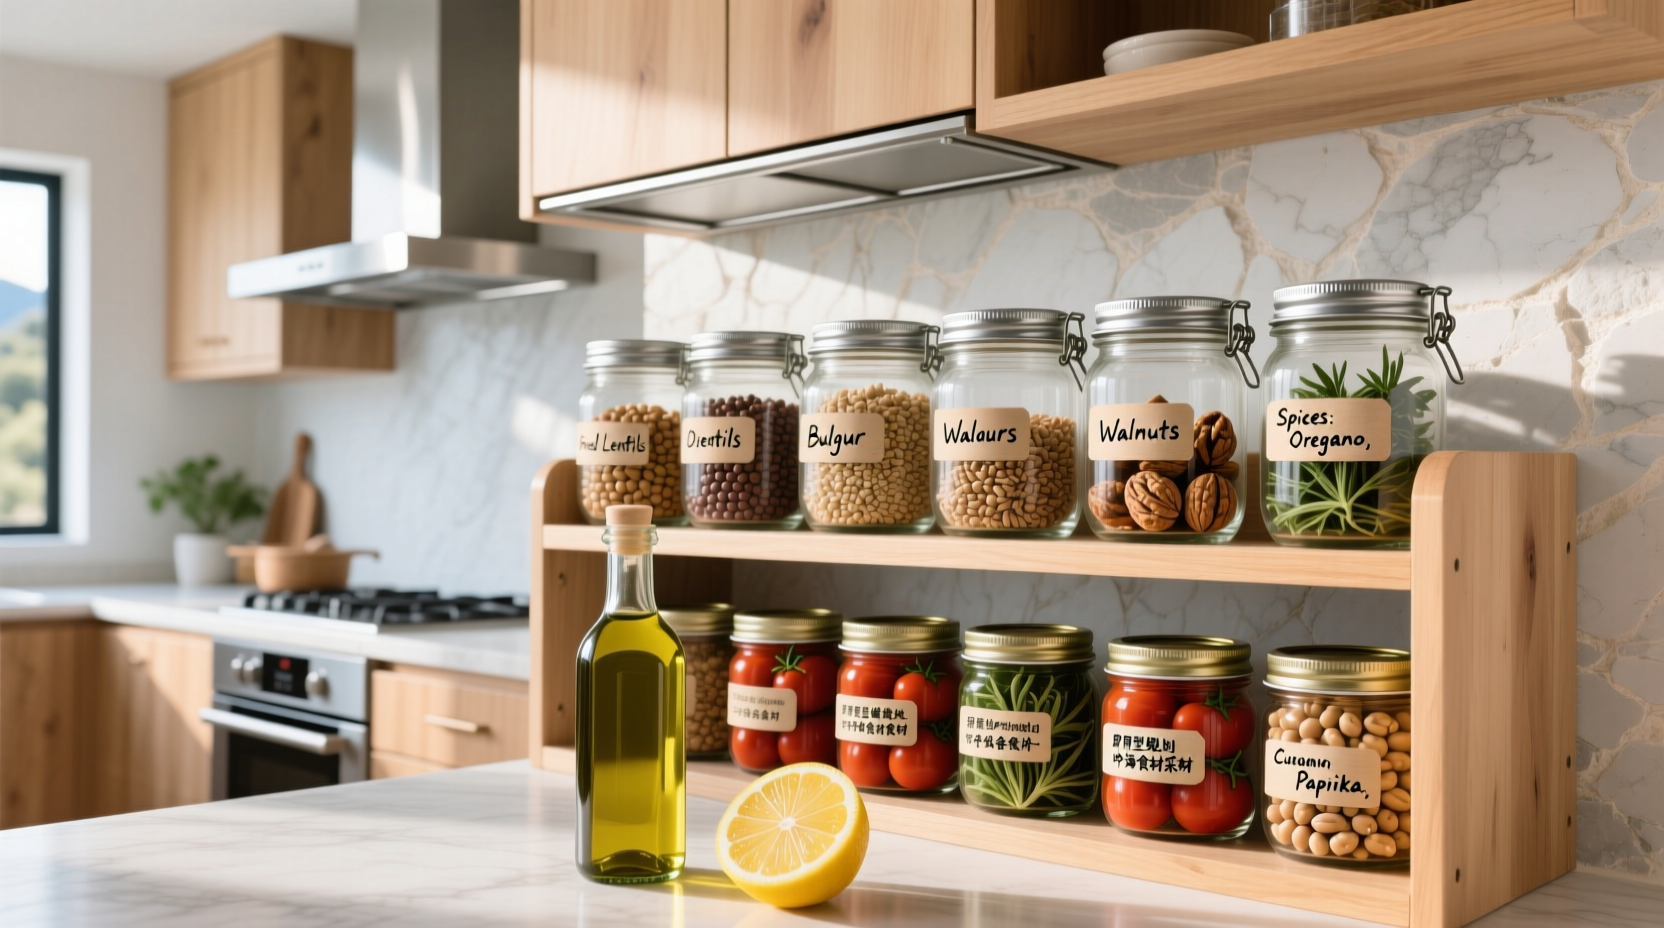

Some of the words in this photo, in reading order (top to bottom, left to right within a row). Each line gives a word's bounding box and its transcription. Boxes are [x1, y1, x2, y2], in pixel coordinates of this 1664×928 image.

[1100, 413, 1180, 442] Walnuts
[1277, 408, 1334, 427] Spices:
[808, 424, 866, 456] Bulgur
[1289, 430, 1371, 456] Oregano,
